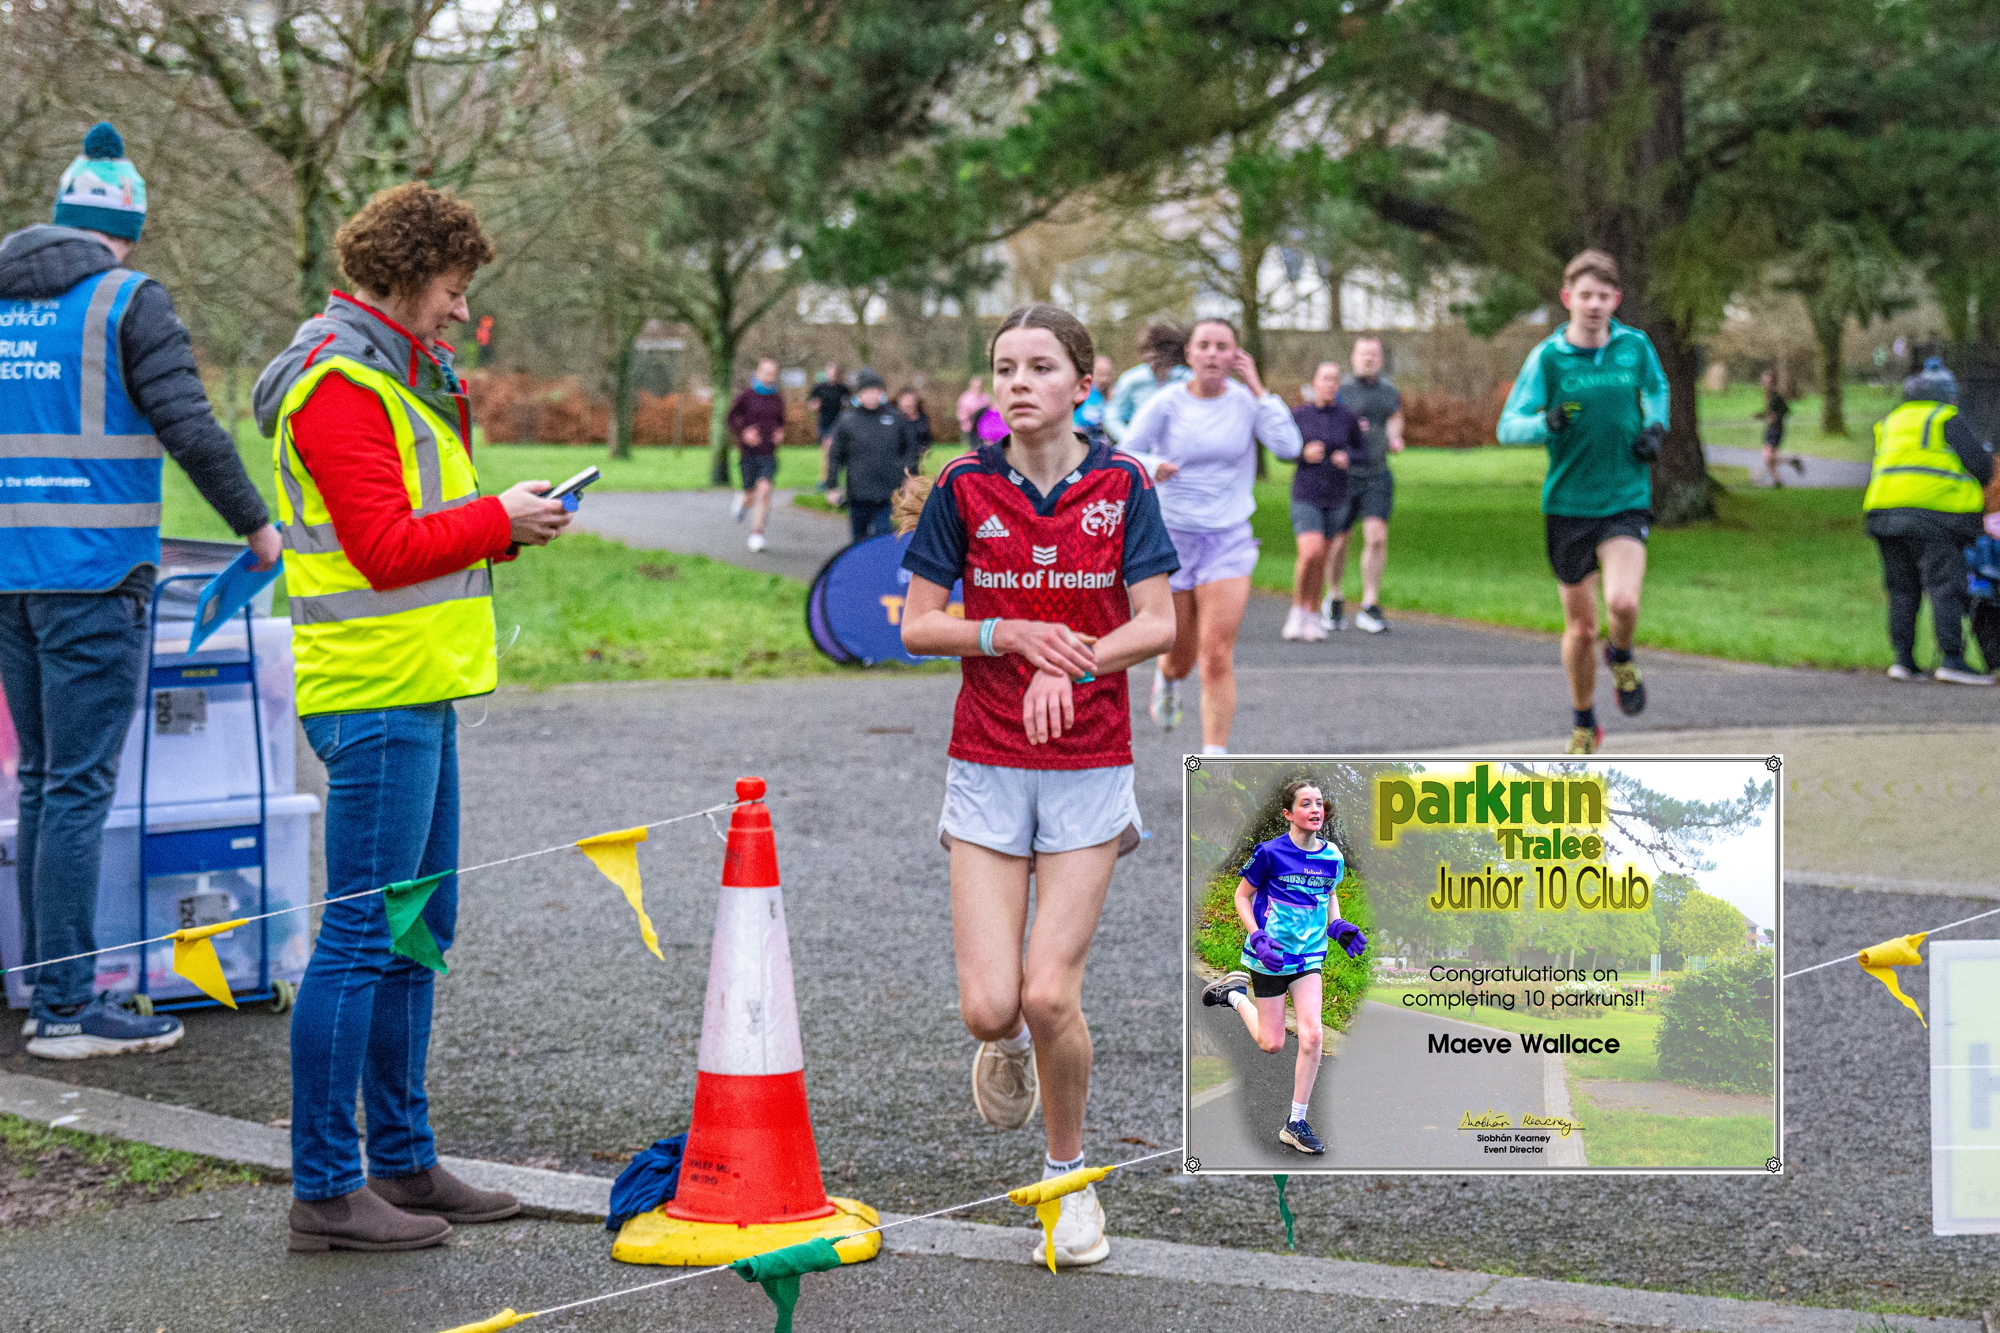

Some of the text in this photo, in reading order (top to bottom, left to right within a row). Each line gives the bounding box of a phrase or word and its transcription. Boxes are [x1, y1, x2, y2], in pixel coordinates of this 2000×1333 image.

[24, 475, 91, 488] volunteers
[975, 529, 1010, 538] adidas
[973, 567, 1117, 589] Bank of Ireland
[45, 1023, 82, 1036] HOKA
